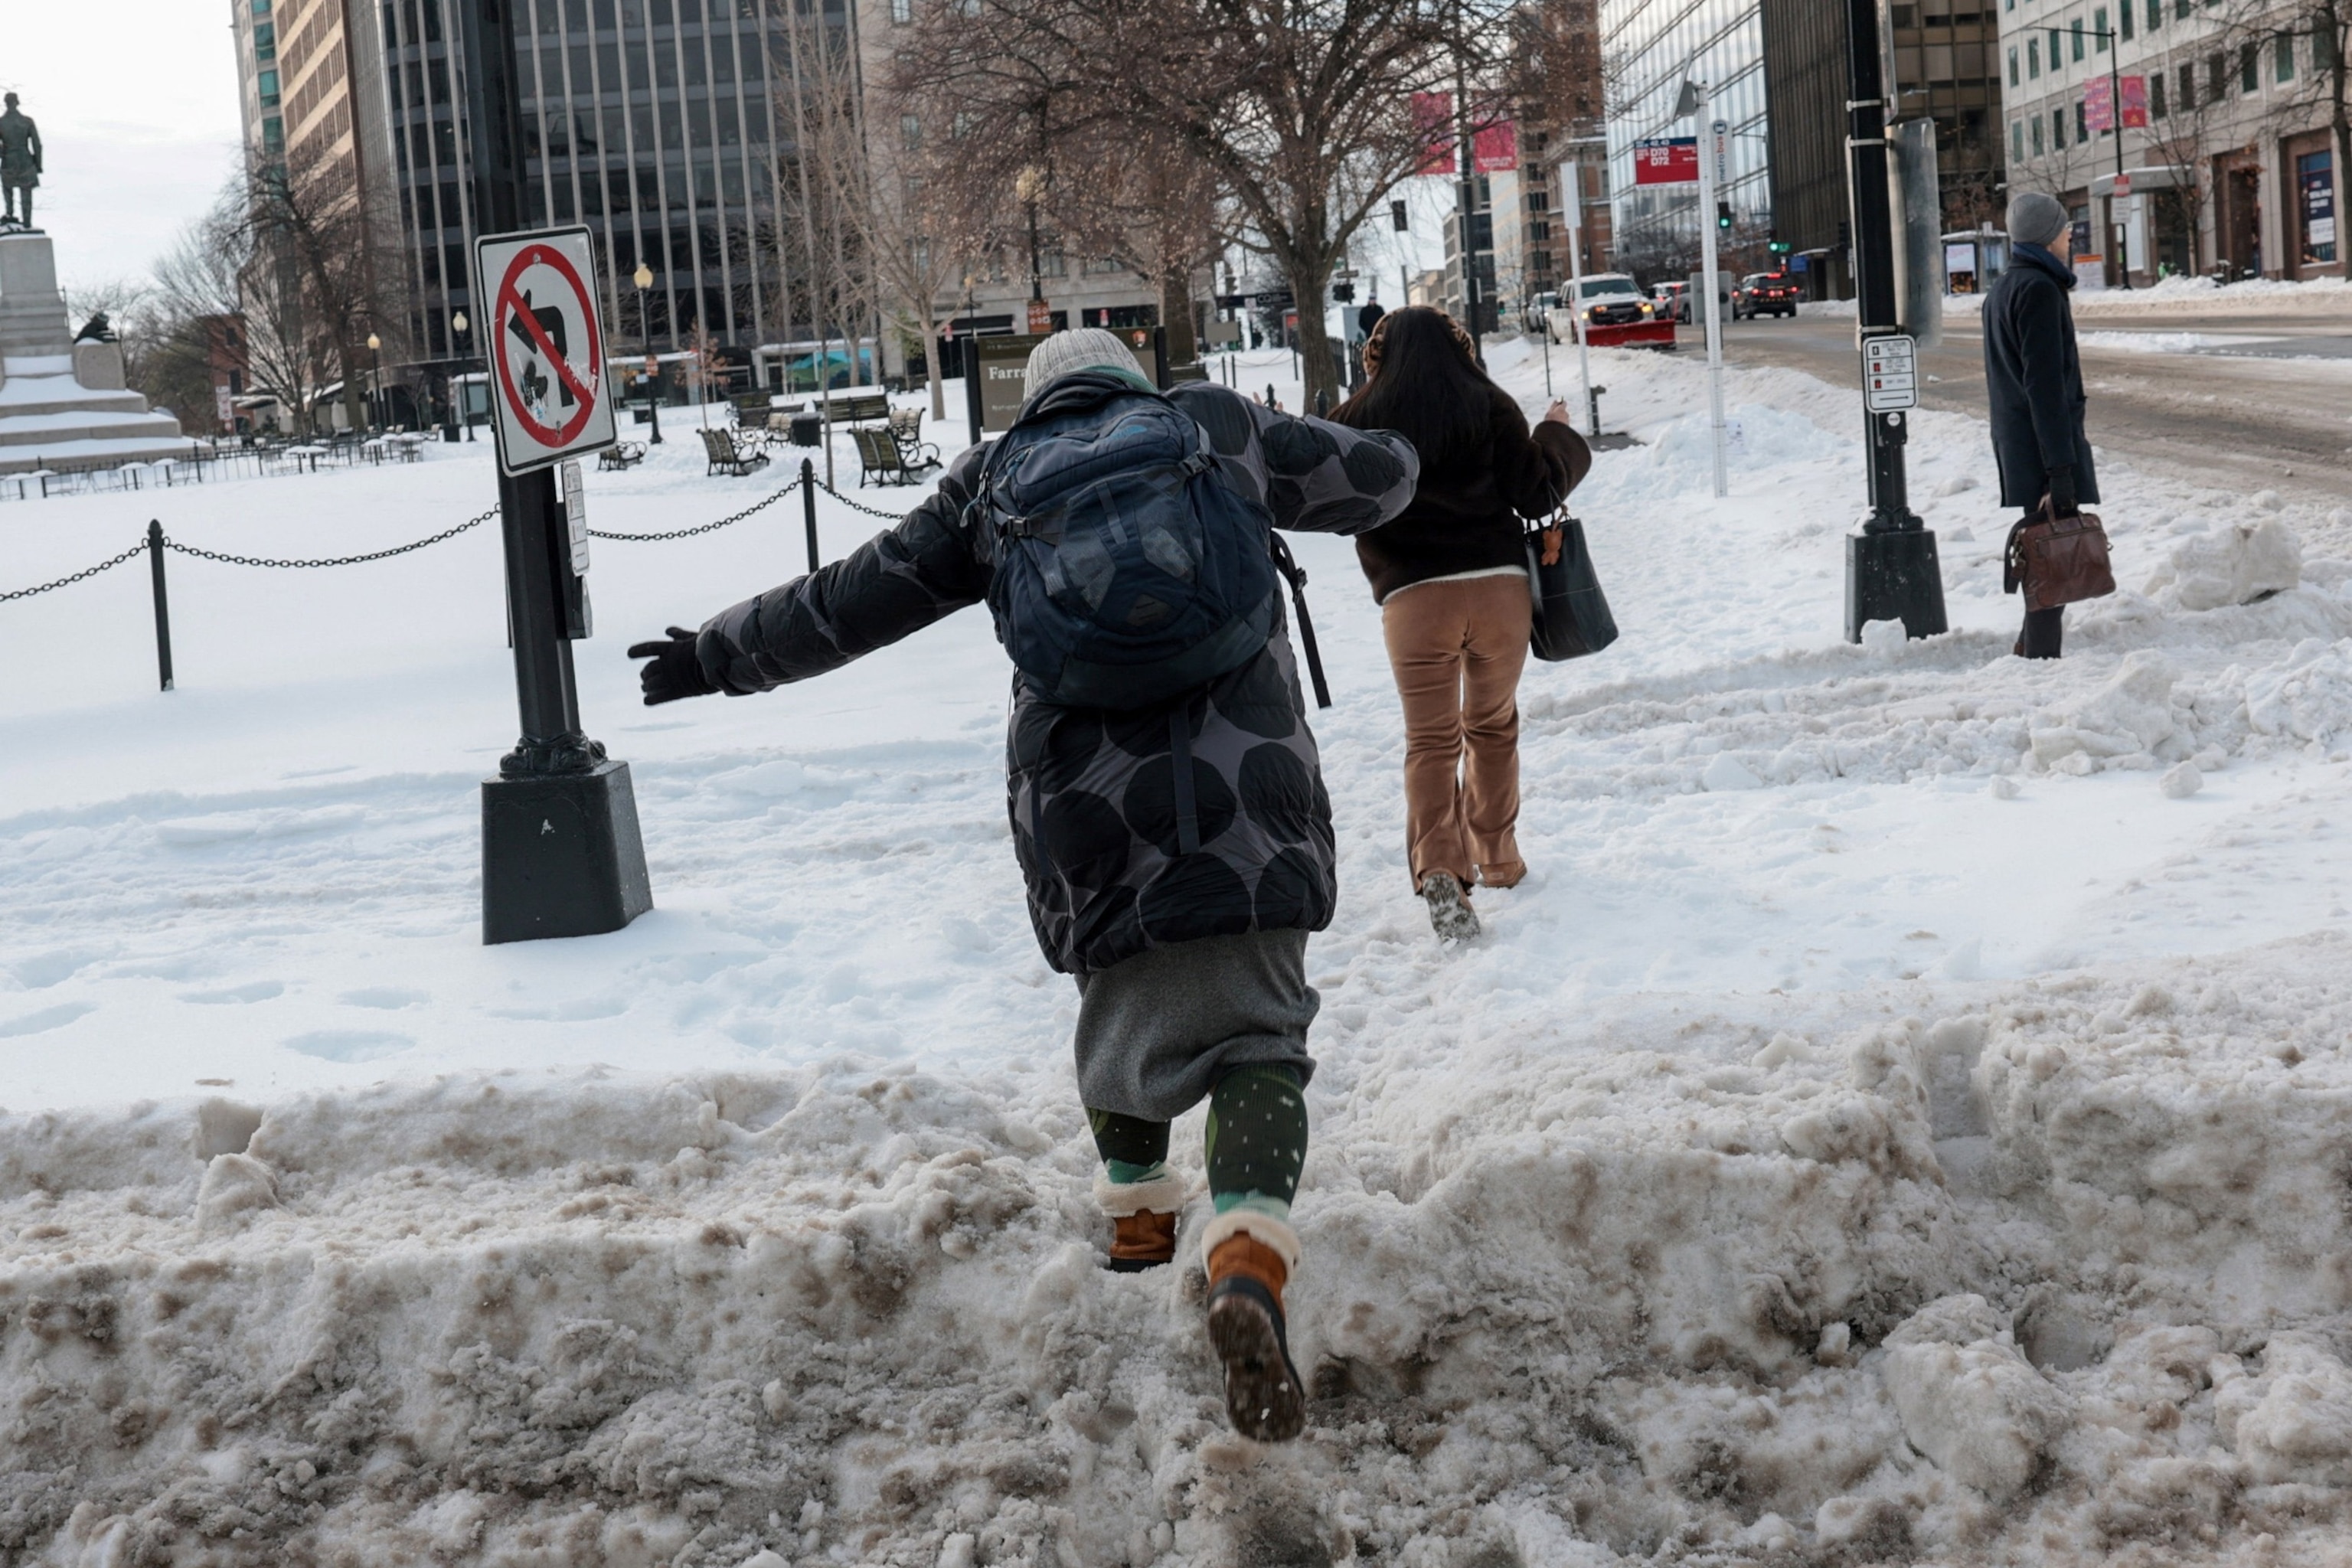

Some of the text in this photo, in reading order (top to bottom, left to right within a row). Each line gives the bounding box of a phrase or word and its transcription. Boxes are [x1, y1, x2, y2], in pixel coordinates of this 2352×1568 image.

[1650, 147, 1669, 157] D70
[1651, 156, 1670, 166] D72
[1717, 136, 1726, 182] metrobus
